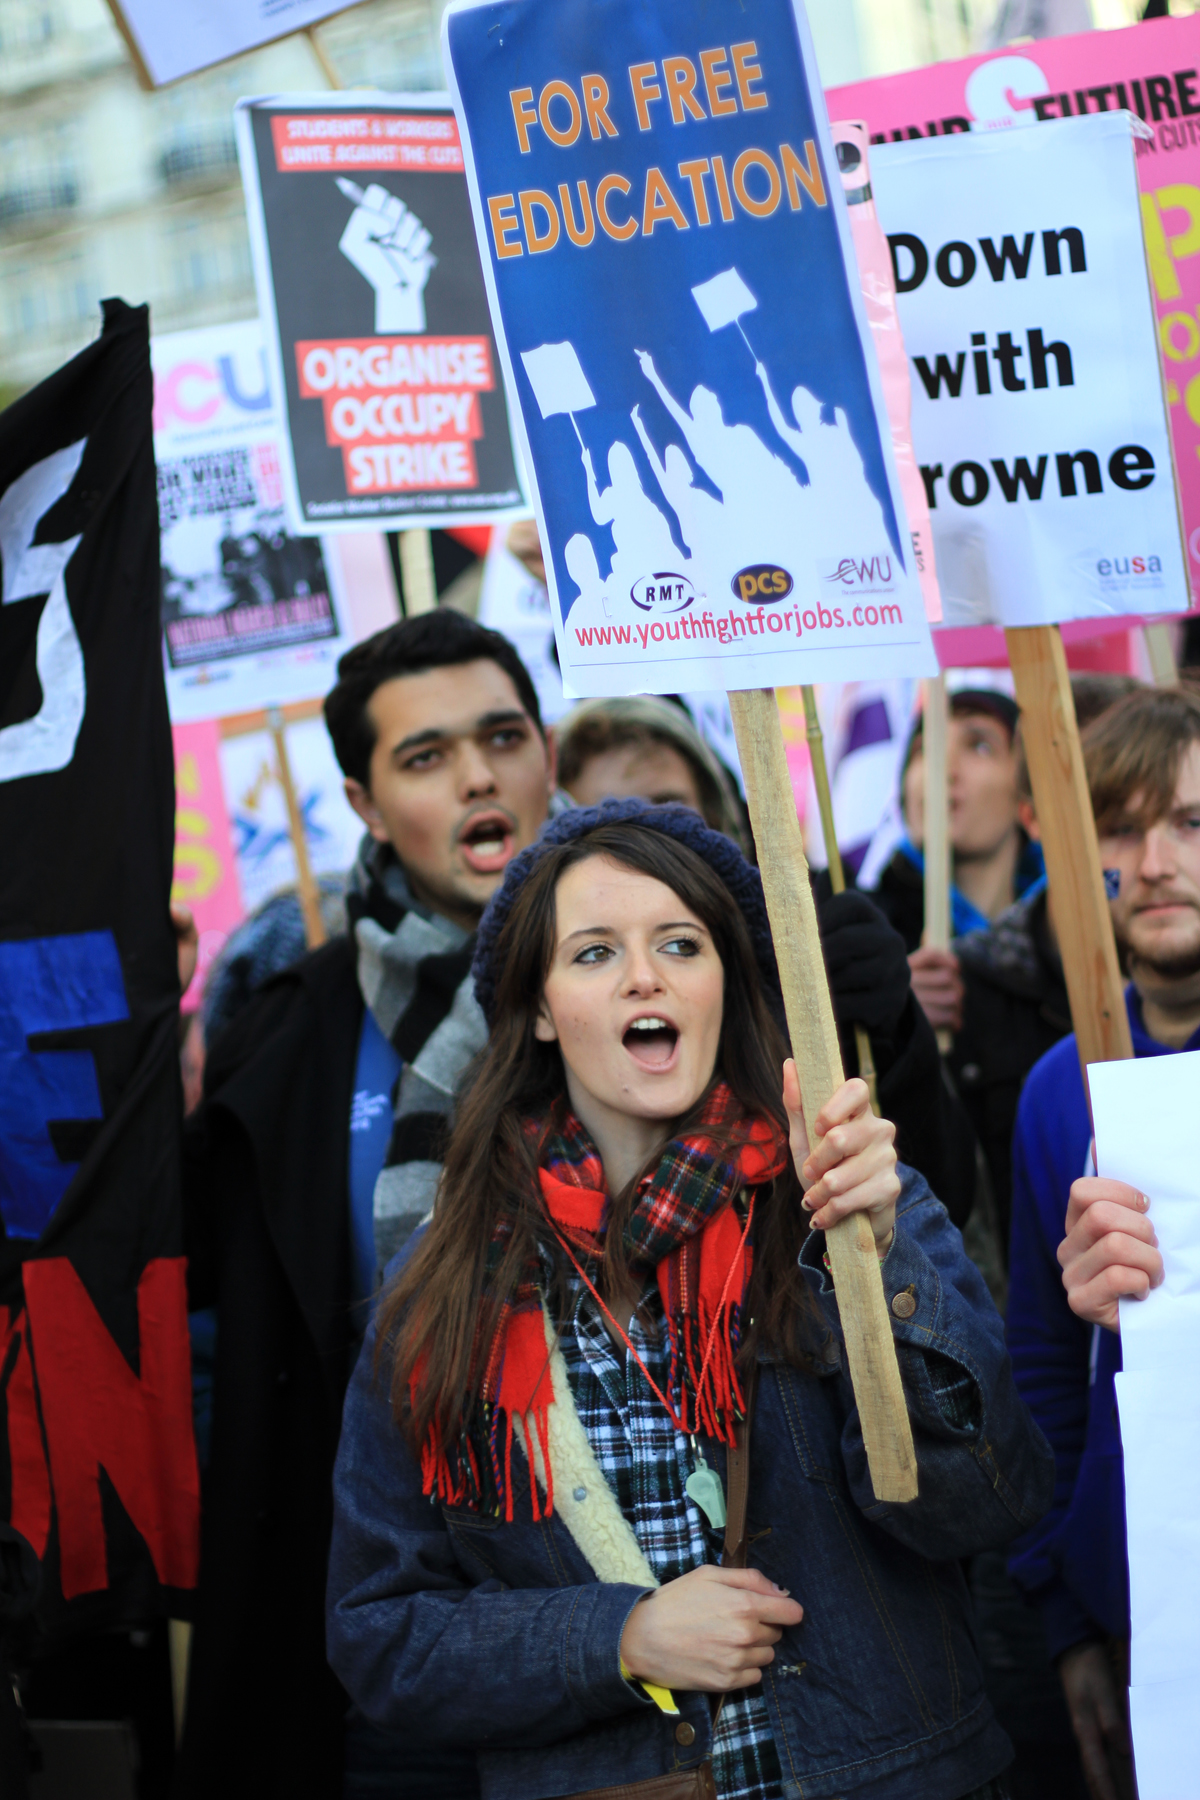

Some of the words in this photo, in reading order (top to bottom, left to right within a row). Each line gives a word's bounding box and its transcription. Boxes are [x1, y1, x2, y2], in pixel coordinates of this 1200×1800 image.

[509, 74, 618, 153] FOR
[628, 41, 768, 131] FREE
[487, 140, 828, 260] EDUCATION
[886, 226, 1088, 293] Down
[303, 344, 488, 391] ORGANISE
[913, 328, 1075, 399] with
[154, 346, 272, 430] CU
[331, 392, 473, 440] OCCUPY
[349, 441, 471, 488] STRIKE
[919, 445, 1156, 508] rowne
[737, 570, 789, 603] pcs
[824, 556, 892, 585] CWU
[1096, 555, 1163, 577] eusa
[645, 583, 685, 602] RMT
[574, 602, 904, 649] www.youthfightforjobs.com
